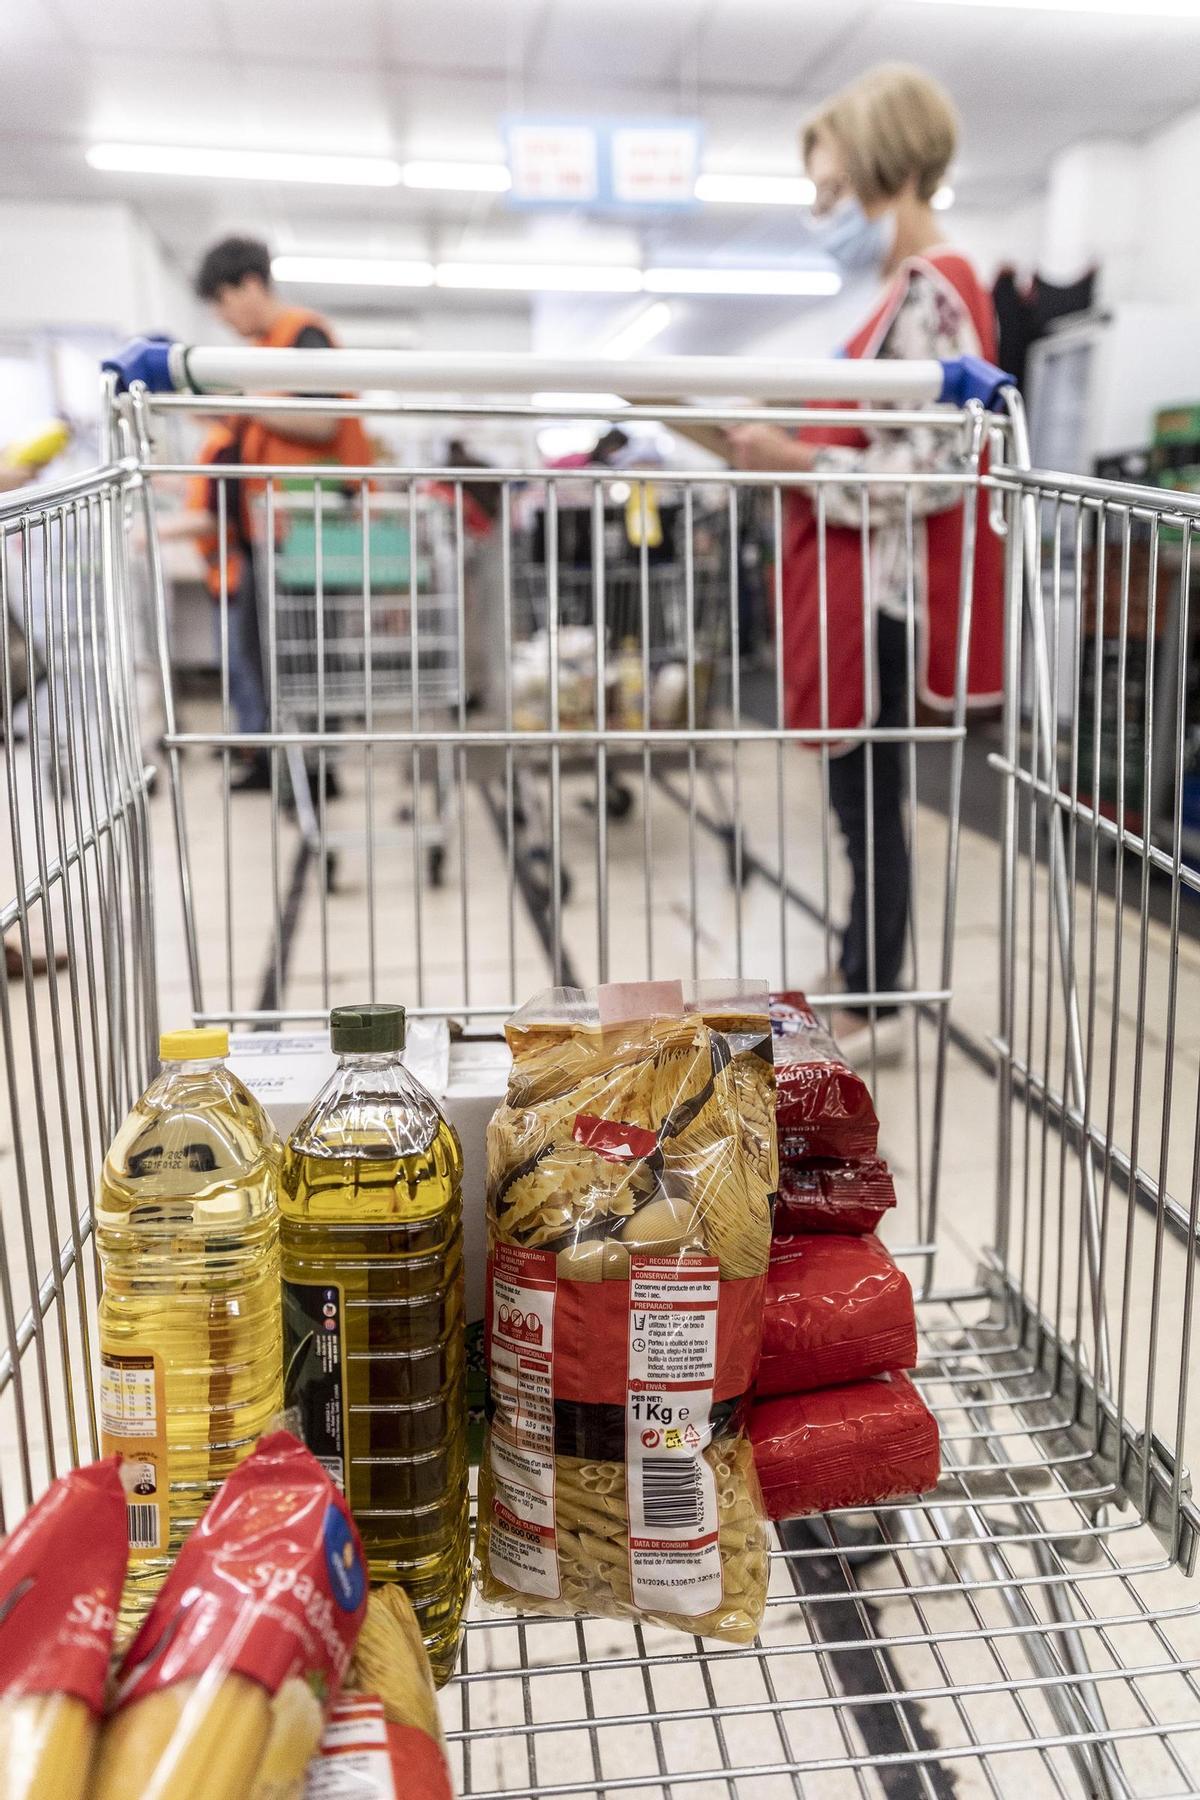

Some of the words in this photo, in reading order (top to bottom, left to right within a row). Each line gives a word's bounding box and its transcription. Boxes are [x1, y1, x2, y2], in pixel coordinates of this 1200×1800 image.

[667, 1285, 688, 1293] producte
[646, 1395, 663, 1403] NET:
[632, 1403, 640, 1420] 1
[646, 1404, 672, 1425] Kg
[634, 1540, 650, 1548] DATA
